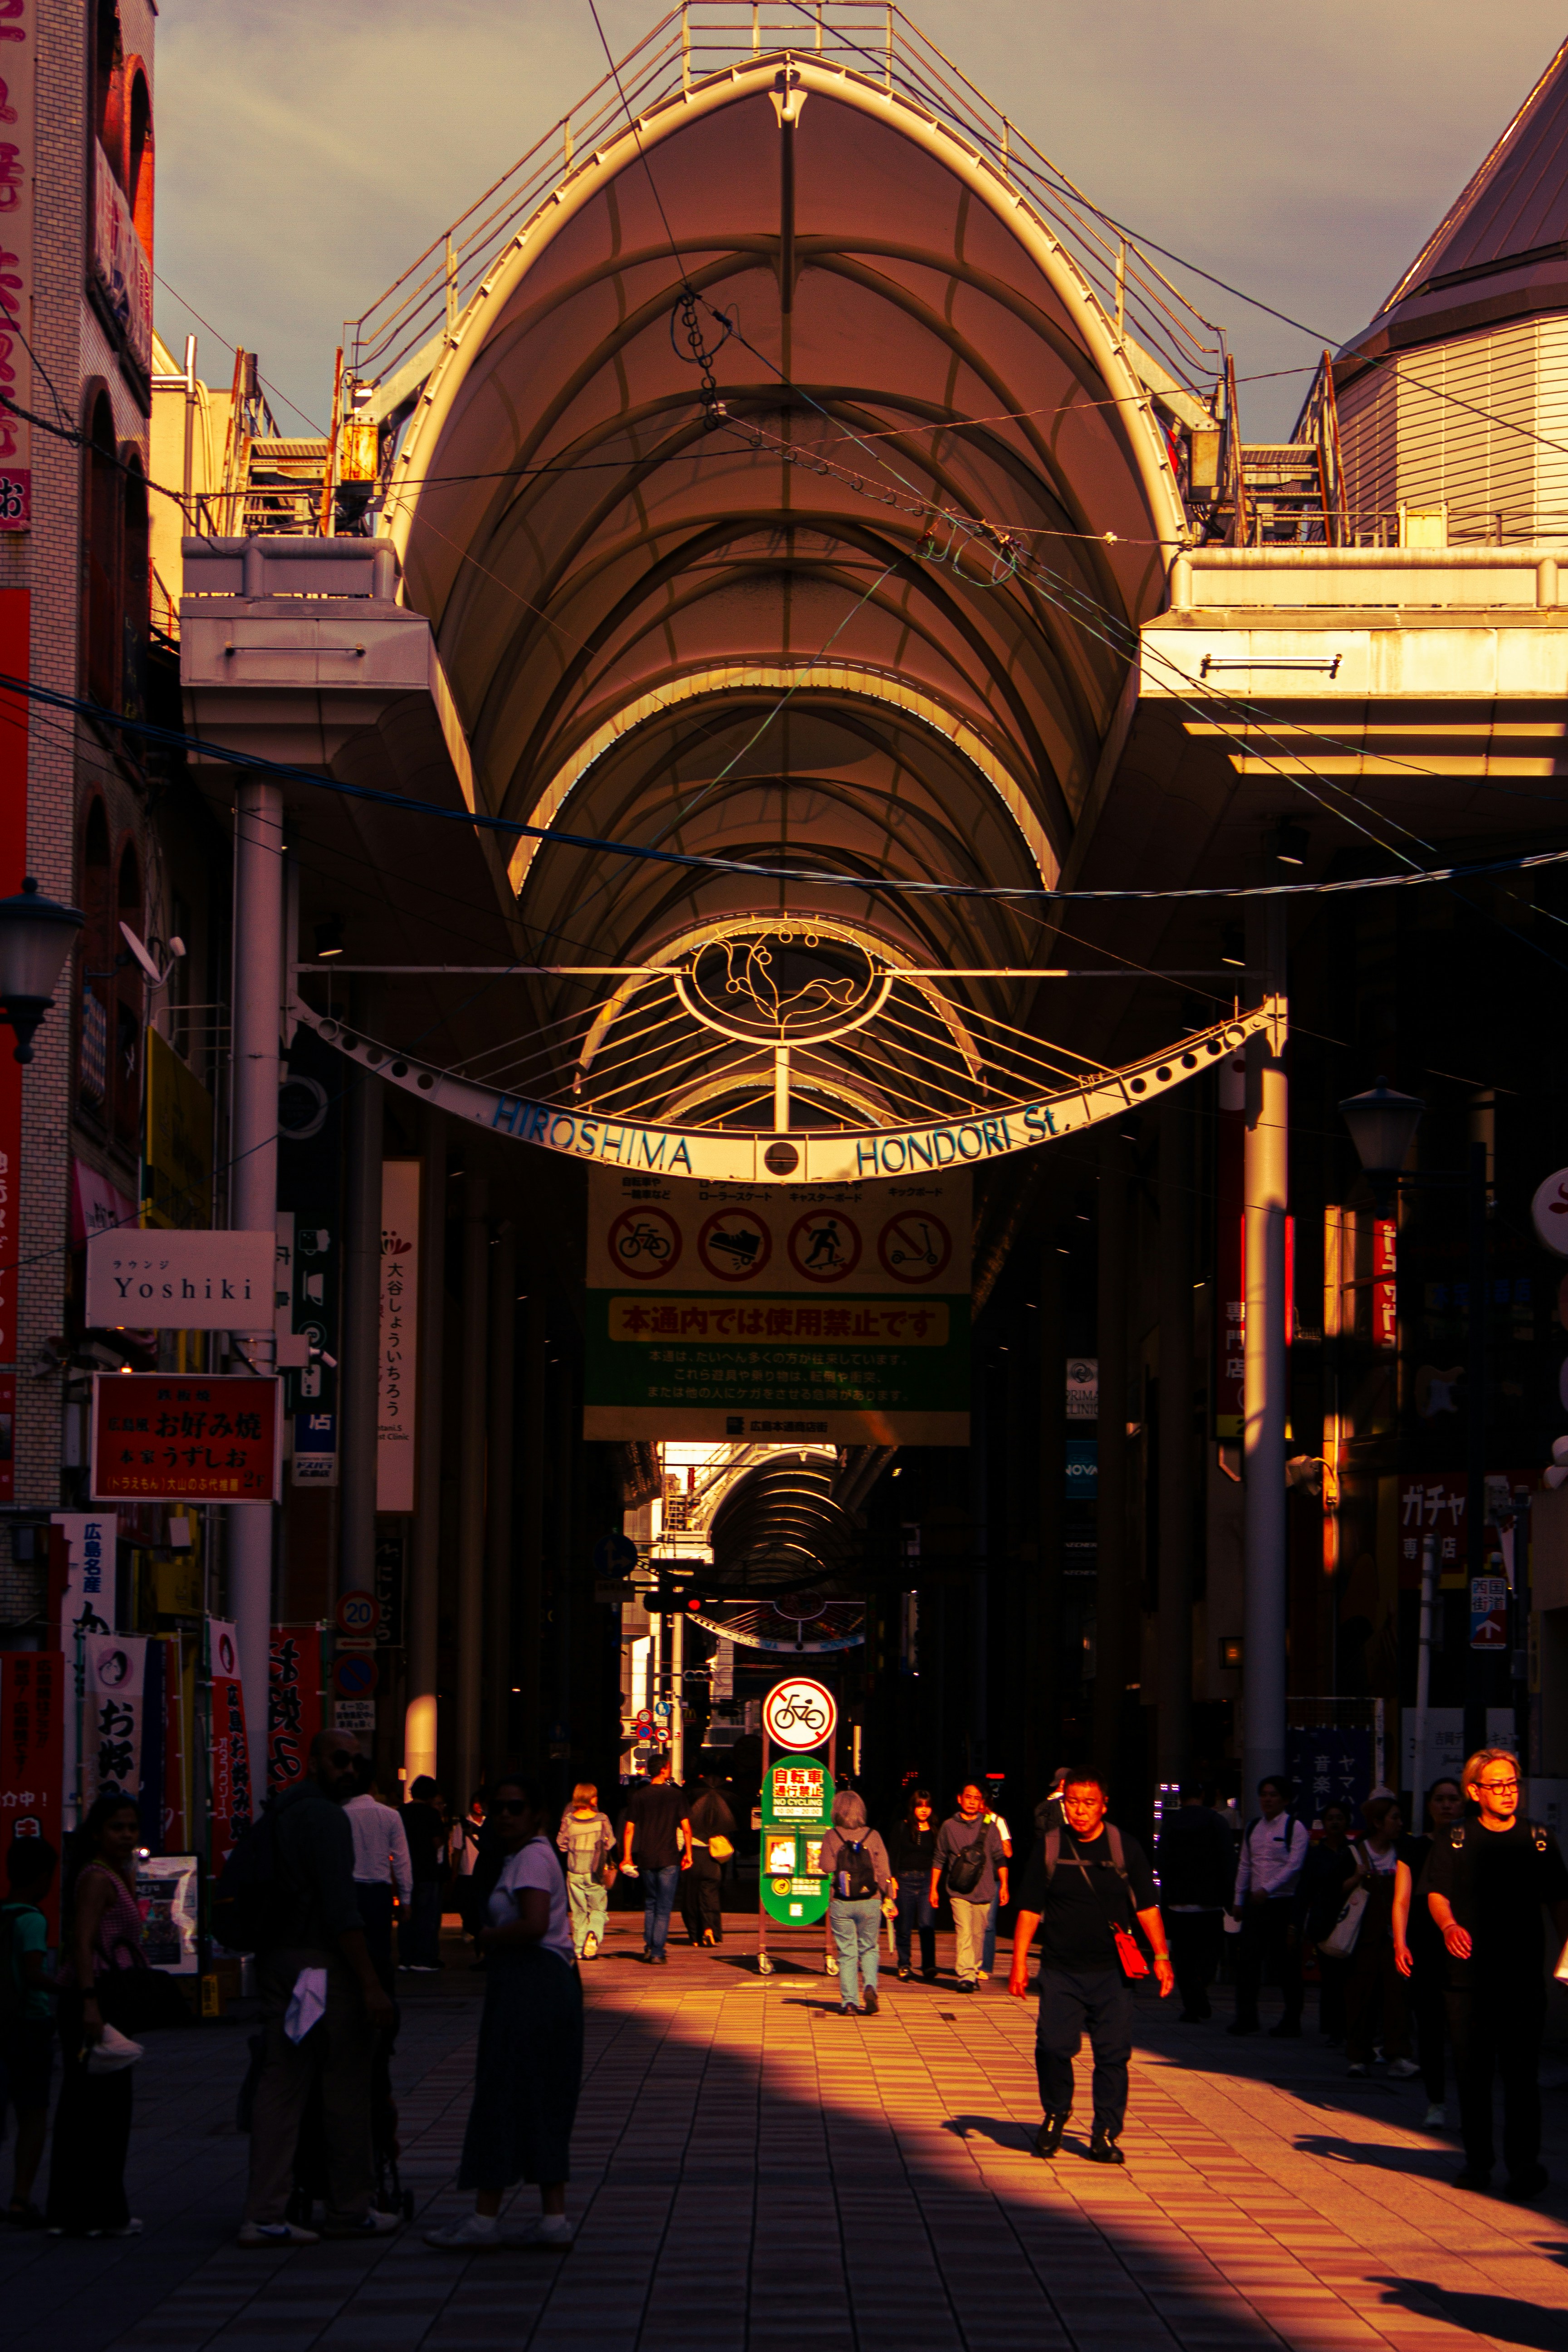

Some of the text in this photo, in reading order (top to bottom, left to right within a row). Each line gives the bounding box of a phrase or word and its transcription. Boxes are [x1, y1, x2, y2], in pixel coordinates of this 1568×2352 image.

[492, 1096, 692, 1174] HIROSHIMA
[857, 1115, 1012, 1176] HONDORI
[622, 1177, 661, 1187] 自転車や
[622, 1189, 671, 1200] 一輪車など
[699, 1191, 772, 1202] ローラースケート
[789, 1192, 862, 1202] キャスターボード
[888, 1187, 943, 1197] キックボード
[113, 1260, 170, 1269] ラウンジ
[114, 1277, 252, 1300] Yoshiki
[622, 1305, 936, 1338] 本通内では使用禁止です
[387, 1263, 403, 1416] 大谷しょういちろう
[648, 1350, 908, 1366] 本通は、たいへん多くの方が往来しています。
[674, 1367, 882, 1383] これら遊具や乗り物は、転倒や衝突、
[647, 1386, 908, 1402] または他の人にケガをさせる危険があります。
[155, 1411, 261, 1441] お好み焼
[750, 1421, 828, 1433] 広島本通商店街
[162, 1446, 247, 1468] うずしお
[1402, 1484, 1466, 1527] ガチャ
[1402, 1536, 1457, 1560] 専店
[84, 1523, 102, 1593] 広島名産
[1472, 1580, 1504, 1594] 西国
[1472, 1596, 1504, 1612] 街道
[346, 1603, 371, 1623] 20
[774, 1769, 822, 1784] 自転車
[774, 1785, 822, 1797] 通行禁止
